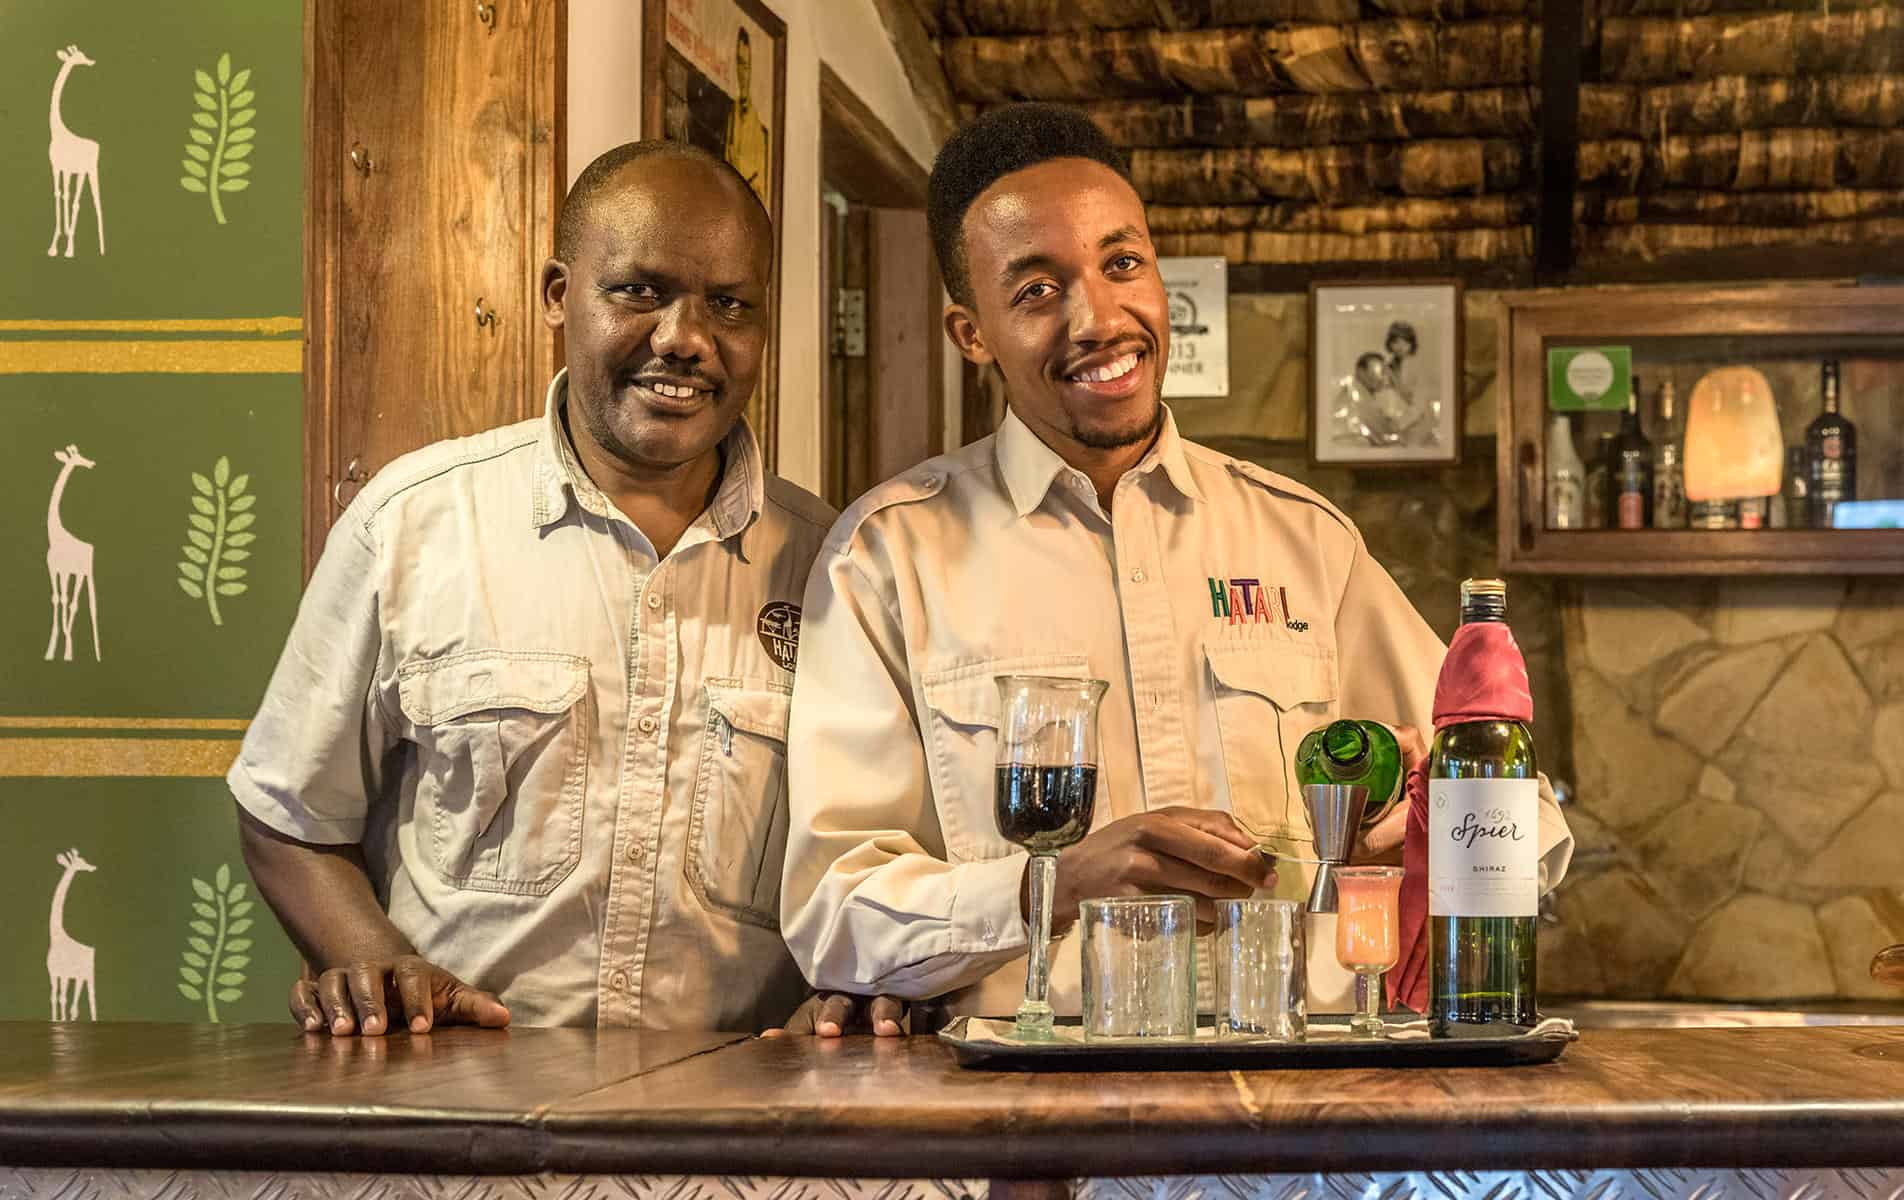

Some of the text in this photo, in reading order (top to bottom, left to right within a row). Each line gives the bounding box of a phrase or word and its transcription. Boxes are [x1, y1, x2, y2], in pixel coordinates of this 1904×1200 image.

[1207, 577, 1290, 626] HATARI
[1450, 813, 1525, 849] Spier
[1472, 865, 1507, 873] SHIRAZ
